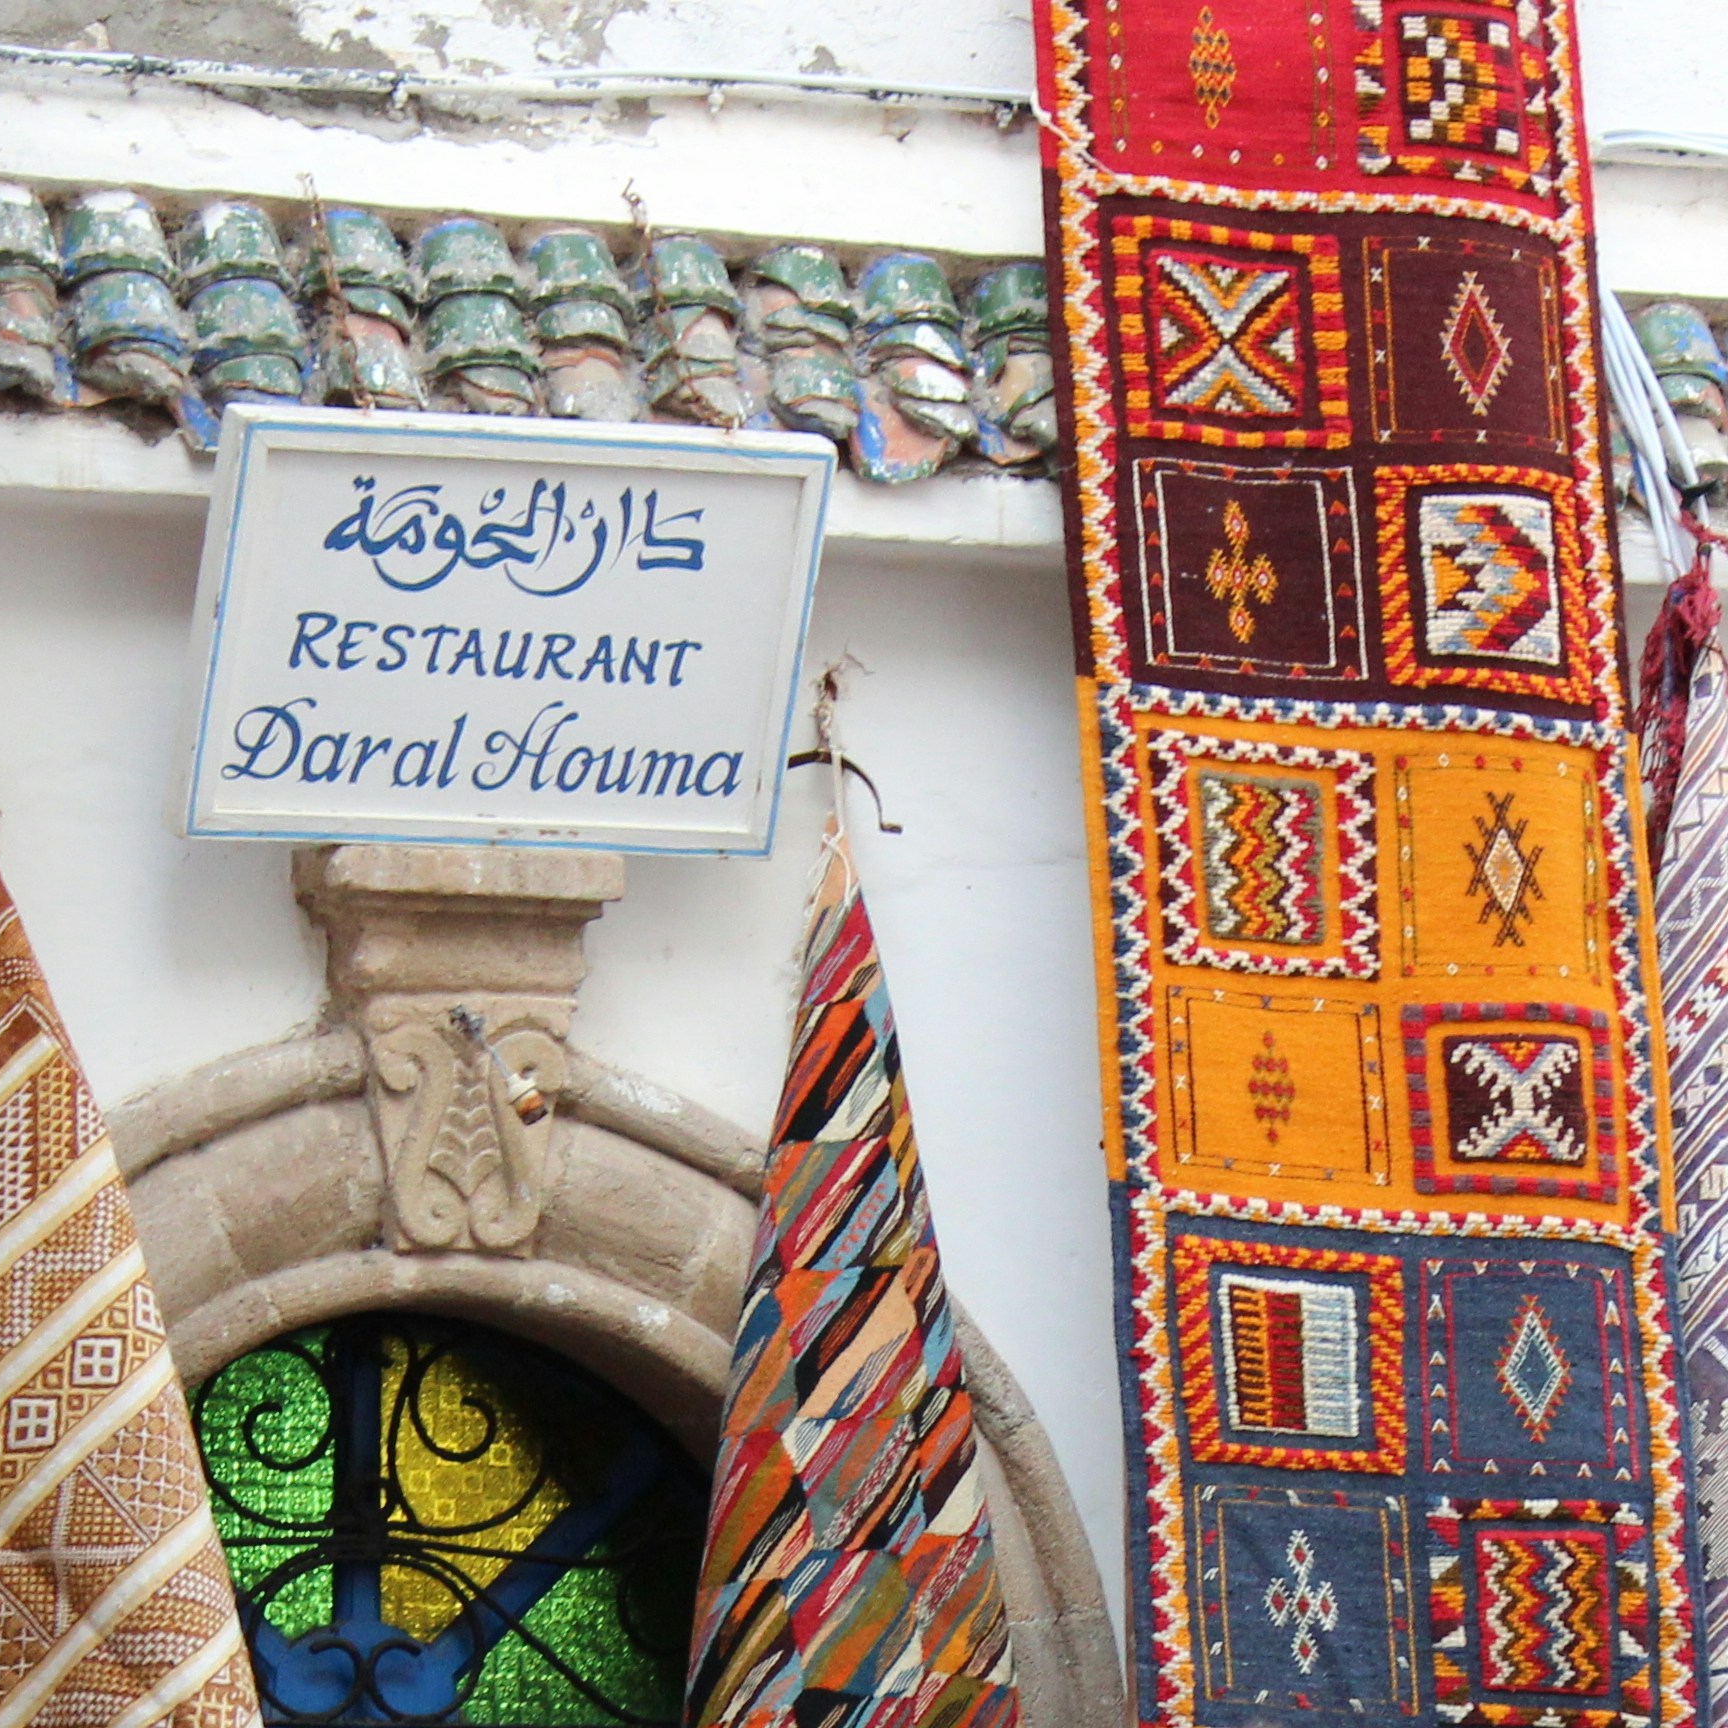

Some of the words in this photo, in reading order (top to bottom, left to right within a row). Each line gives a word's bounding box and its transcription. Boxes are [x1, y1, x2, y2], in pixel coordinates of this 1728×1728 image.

[289, 612, 702, 687] RESTAURANT
[220, 698, 389, 784] Dar
[391, 713, 470, 788] al
[472, 701, 745, 797] Houma
